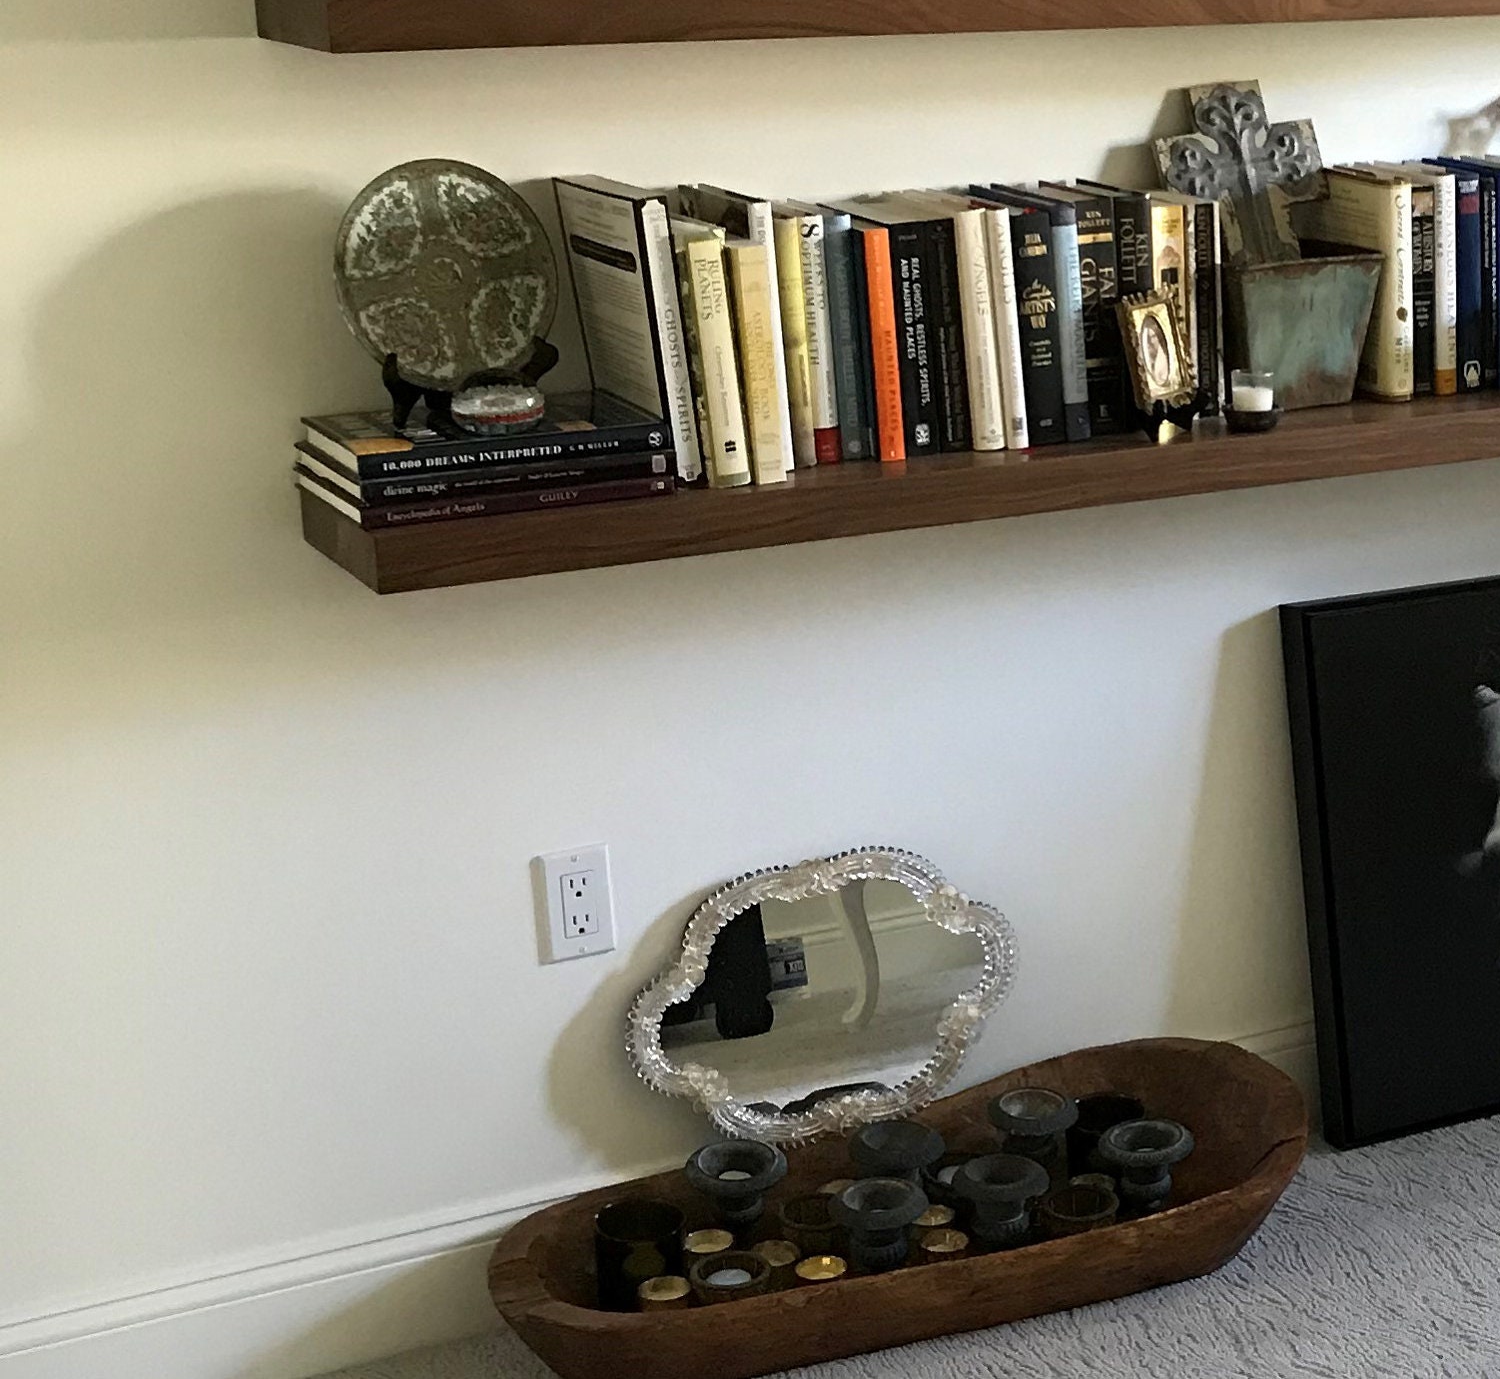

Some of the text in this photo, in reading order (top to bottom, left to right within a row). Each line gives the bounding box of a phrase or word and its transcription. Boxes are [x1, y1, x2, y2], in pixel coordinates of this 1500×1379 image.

[800, 222, 820, 239] 8
[1121, 218, 1137, 284] FOLLETT
[1136, 233, 1149, 266] KEN
[1422, 230, 1432, 273] HISTORY
[695, 258, 713, 321] PLANETS
[707, 260, 724, 314] RULING
[801, 241, 820, 365] OPTIMUM HEALTH
[900, 259, 916, 359] AND HAUNTED PLACES
[910, 257, 920, 280] REAL
[916, 324, 927, 366] RESTLESS
[664, 309, 681, 368] GHOSTS
[884, 330, 899, 432] HAUNTED PLACES
[675, 387, 691, 443] SPIRITS
[426, 455, 475, 467] DREAMS
[479, 445, 562, 461] INTERPRETED
[383, 483, 448, 497] divine magic
